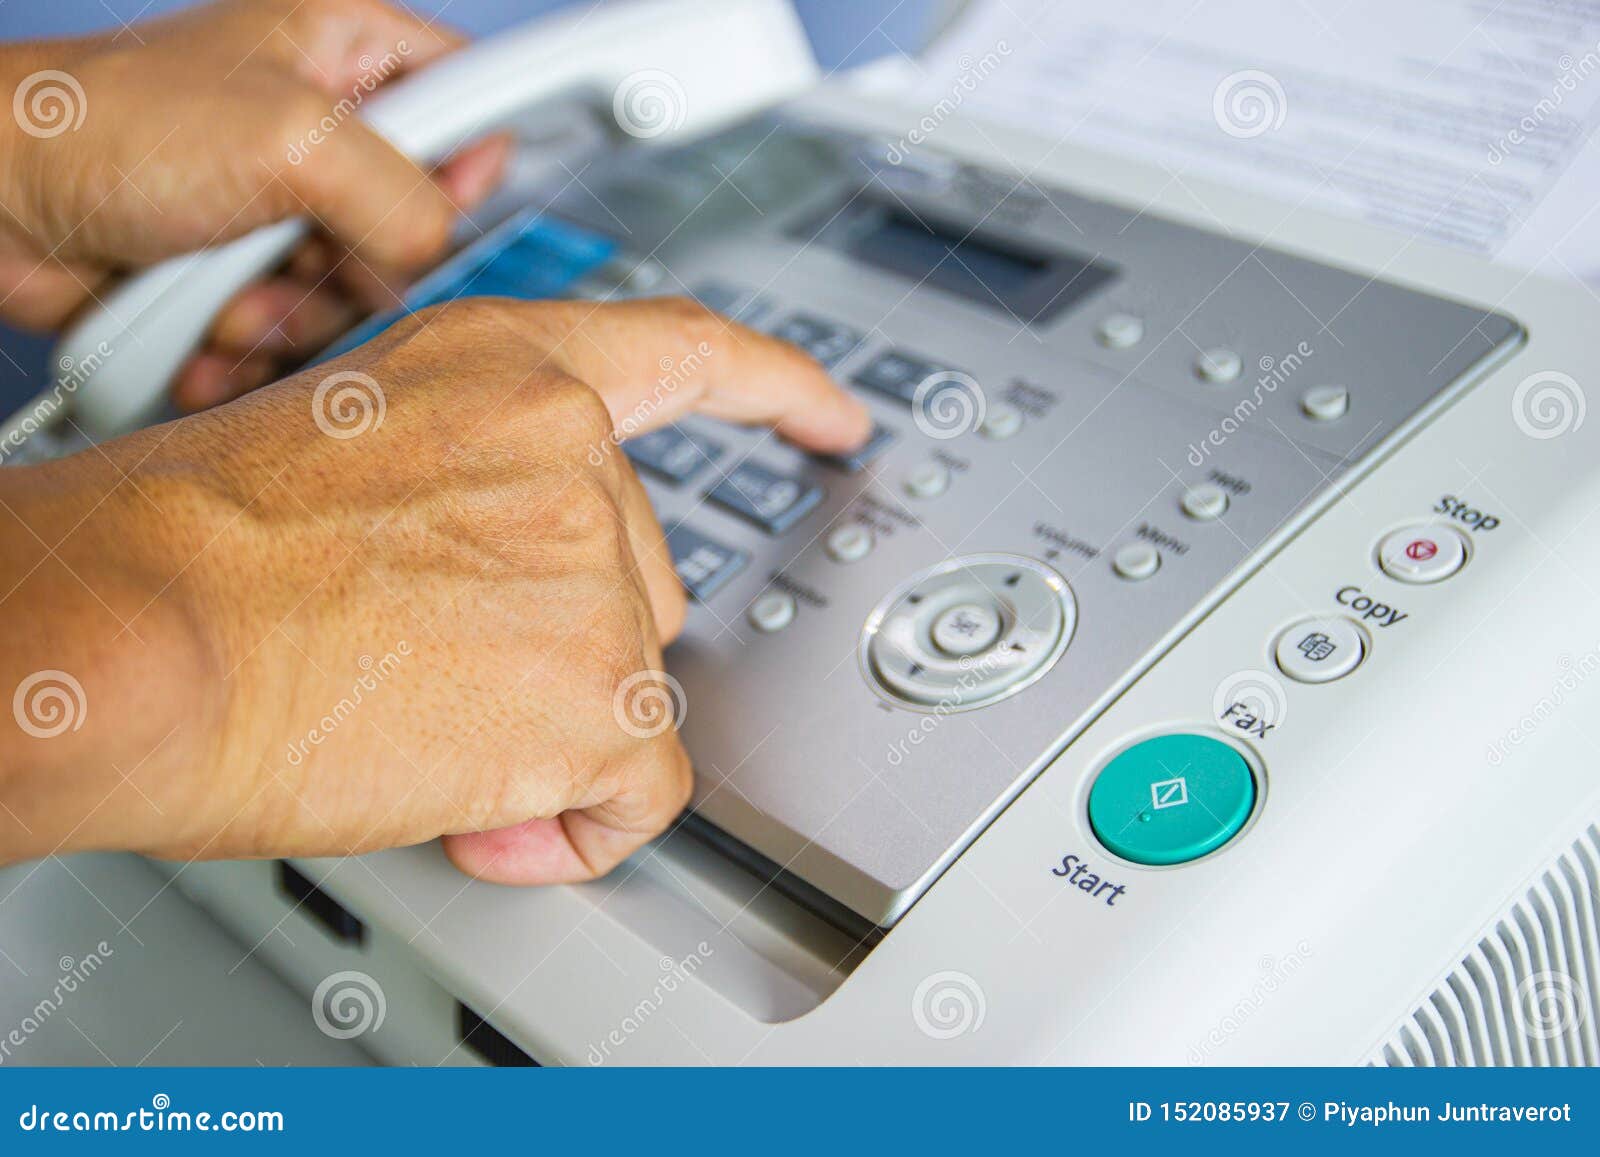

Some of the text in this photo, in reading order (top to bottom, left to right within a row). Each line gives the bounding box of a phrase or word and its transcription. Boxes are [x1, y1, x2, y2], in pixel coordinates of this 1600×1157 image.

[1432, 494, 1501, 532] Stop
[1135, 521, 1191, 556] Menu
[1335, 585, 1409, 628] Copy
[1220, 702, 1275, 738] Fax
[1052, 854, 1126, 906] Start
